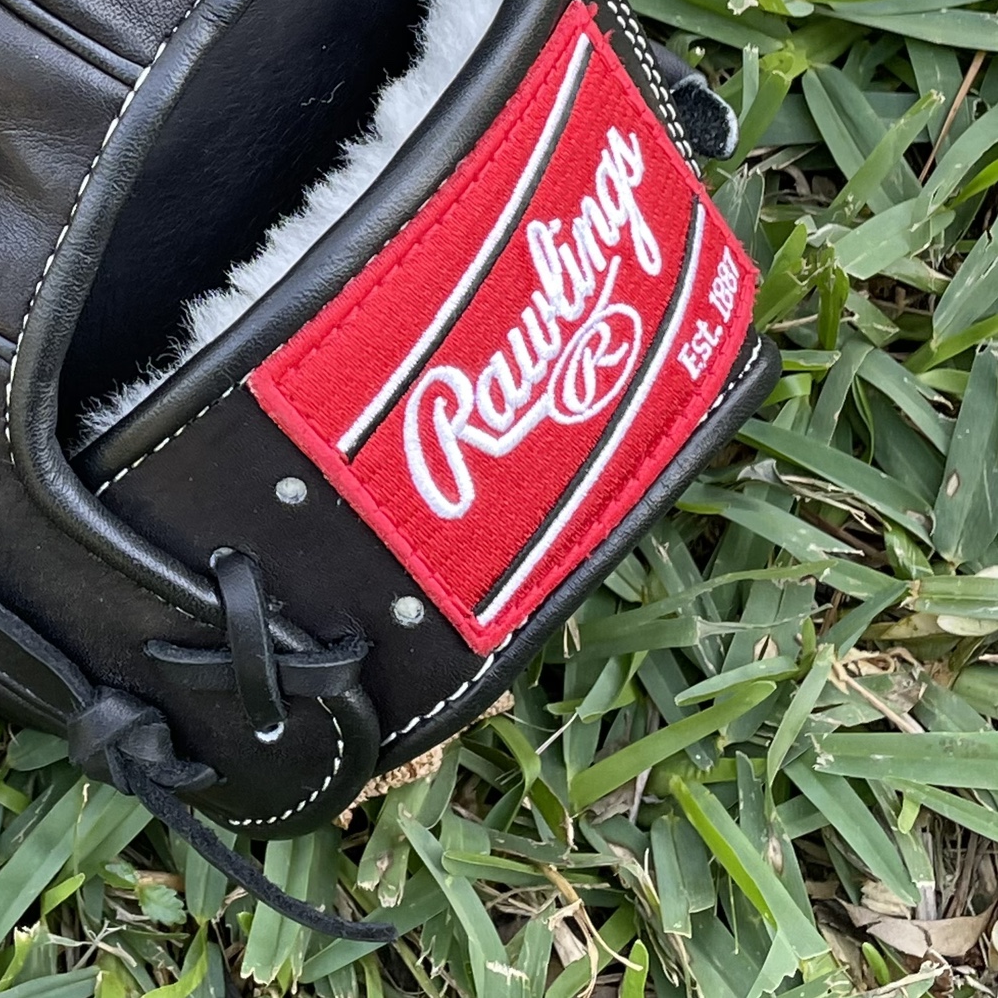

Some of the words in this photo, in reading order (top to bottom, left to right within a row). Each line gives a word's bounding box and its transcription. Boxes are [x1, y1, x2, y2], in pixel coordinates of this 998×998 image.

[402, 126, 662, 520] Rawlings
[677, 319, 723, 381] Est.
[708, 245, 740, 323] 1887
